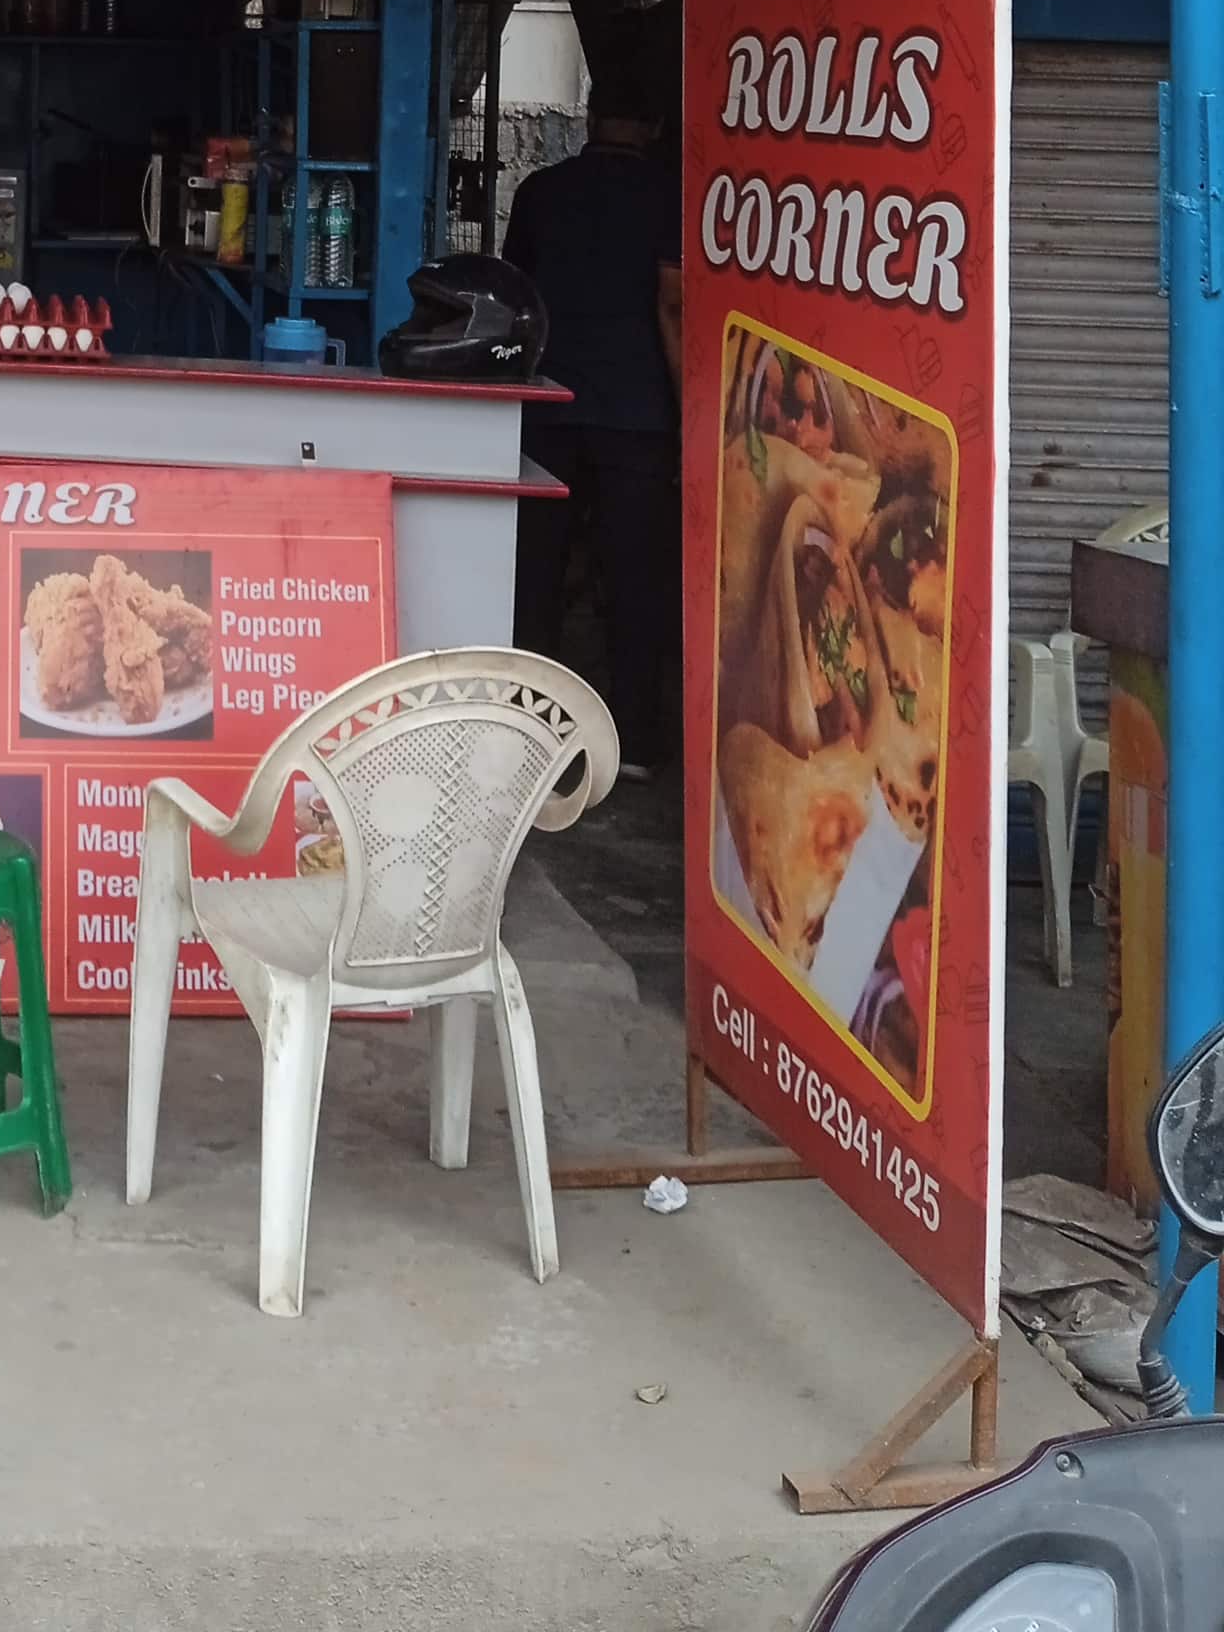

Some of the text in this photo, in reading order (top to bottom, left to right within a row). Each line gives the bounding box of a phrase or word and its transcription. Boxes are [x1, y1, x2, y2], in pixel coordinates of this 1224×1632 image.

[721, 34, 940, 143] ROLLS
[701, 174, 966, 313] CORNER
[490, 344, 524, 361] Tiger
[219, 576, 370, 603] Fried Chicken
[220, 609, 322, 643] Popcorn
[220, 645, 297, 678] Wings
[221, 682, 265, 716] Leg
[77, 778, 147, 807] Mom
[77, 868, 139, 898] Brea
[712, 983, 756, 1061] Cell
[775, 1042, 941, 1233] 8762941425
